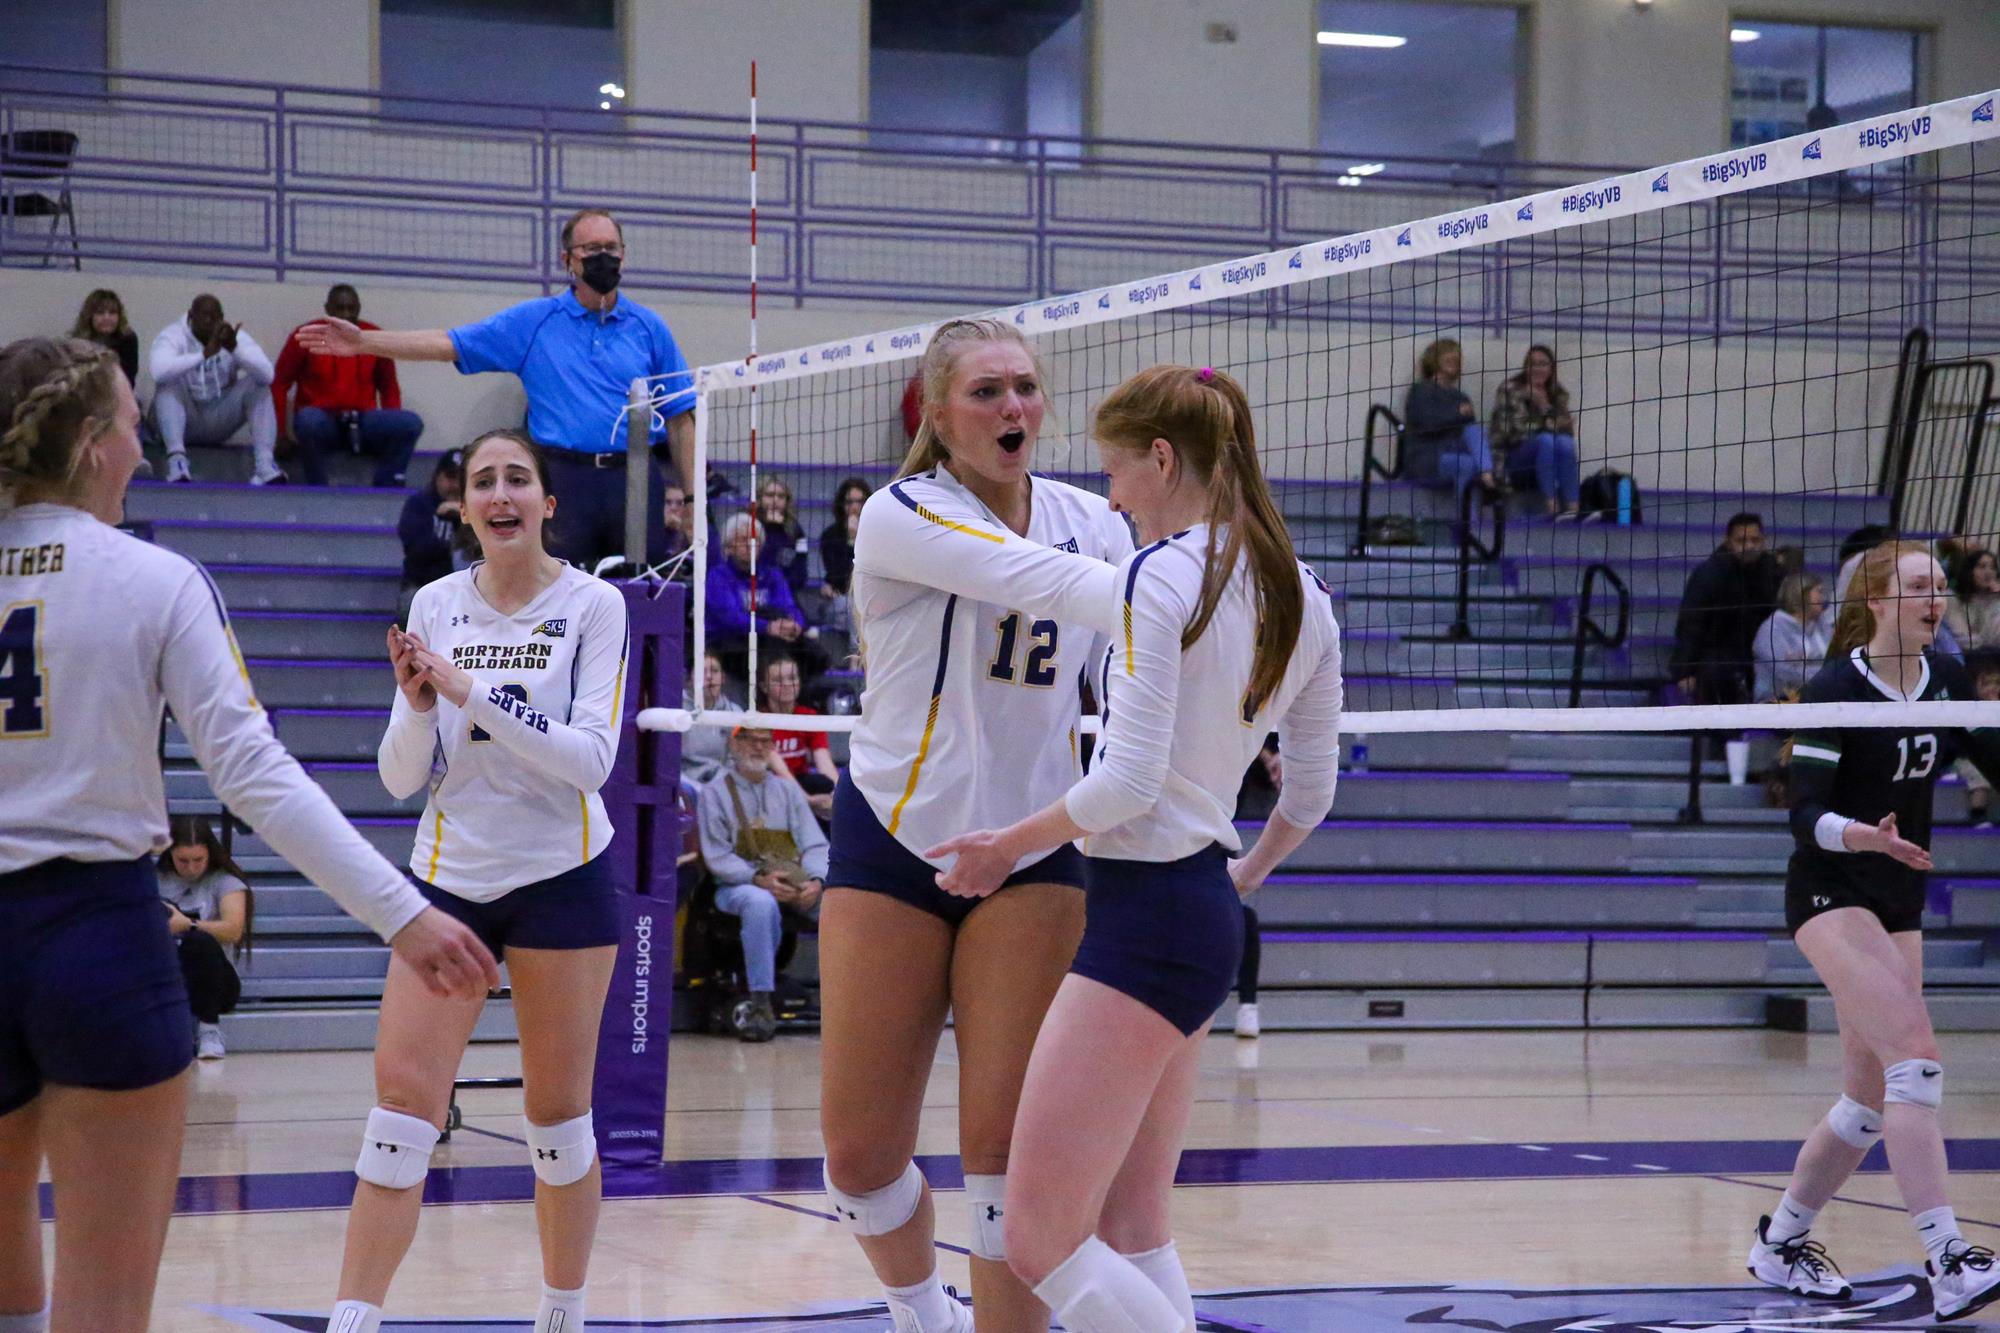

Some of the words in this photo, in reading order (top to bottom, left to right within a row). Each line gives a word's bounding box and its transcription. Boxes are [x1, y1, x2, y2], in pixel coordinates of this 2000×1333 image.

[1222, 262, 1267, 284] #BigSkyVB
[1324, 239, 1372, 263] #BigSkyVB
[1438, 213, 1489, 239] #BigSkyVB
[1562, 185, 1621, 214] #BigSkyVB
[1702, 153, 1767, 184] #BigSkyVB
[1858, 116, 1932, 150] #BigSkyVB
[0, 543, 64, 577] THER
[545, 620, 566, 633] SKY
[987, 609, 1059, 688] 12
[452, 643, 553, 660] NORTHERN
[454, 657, 547, 670] COLORADO
[487, 686, 549, 735] BEARS
[1892, 733, 1938, 782] 13
[634, 915, 653, 977] sports
[631, 979, 649, 1054] imports
